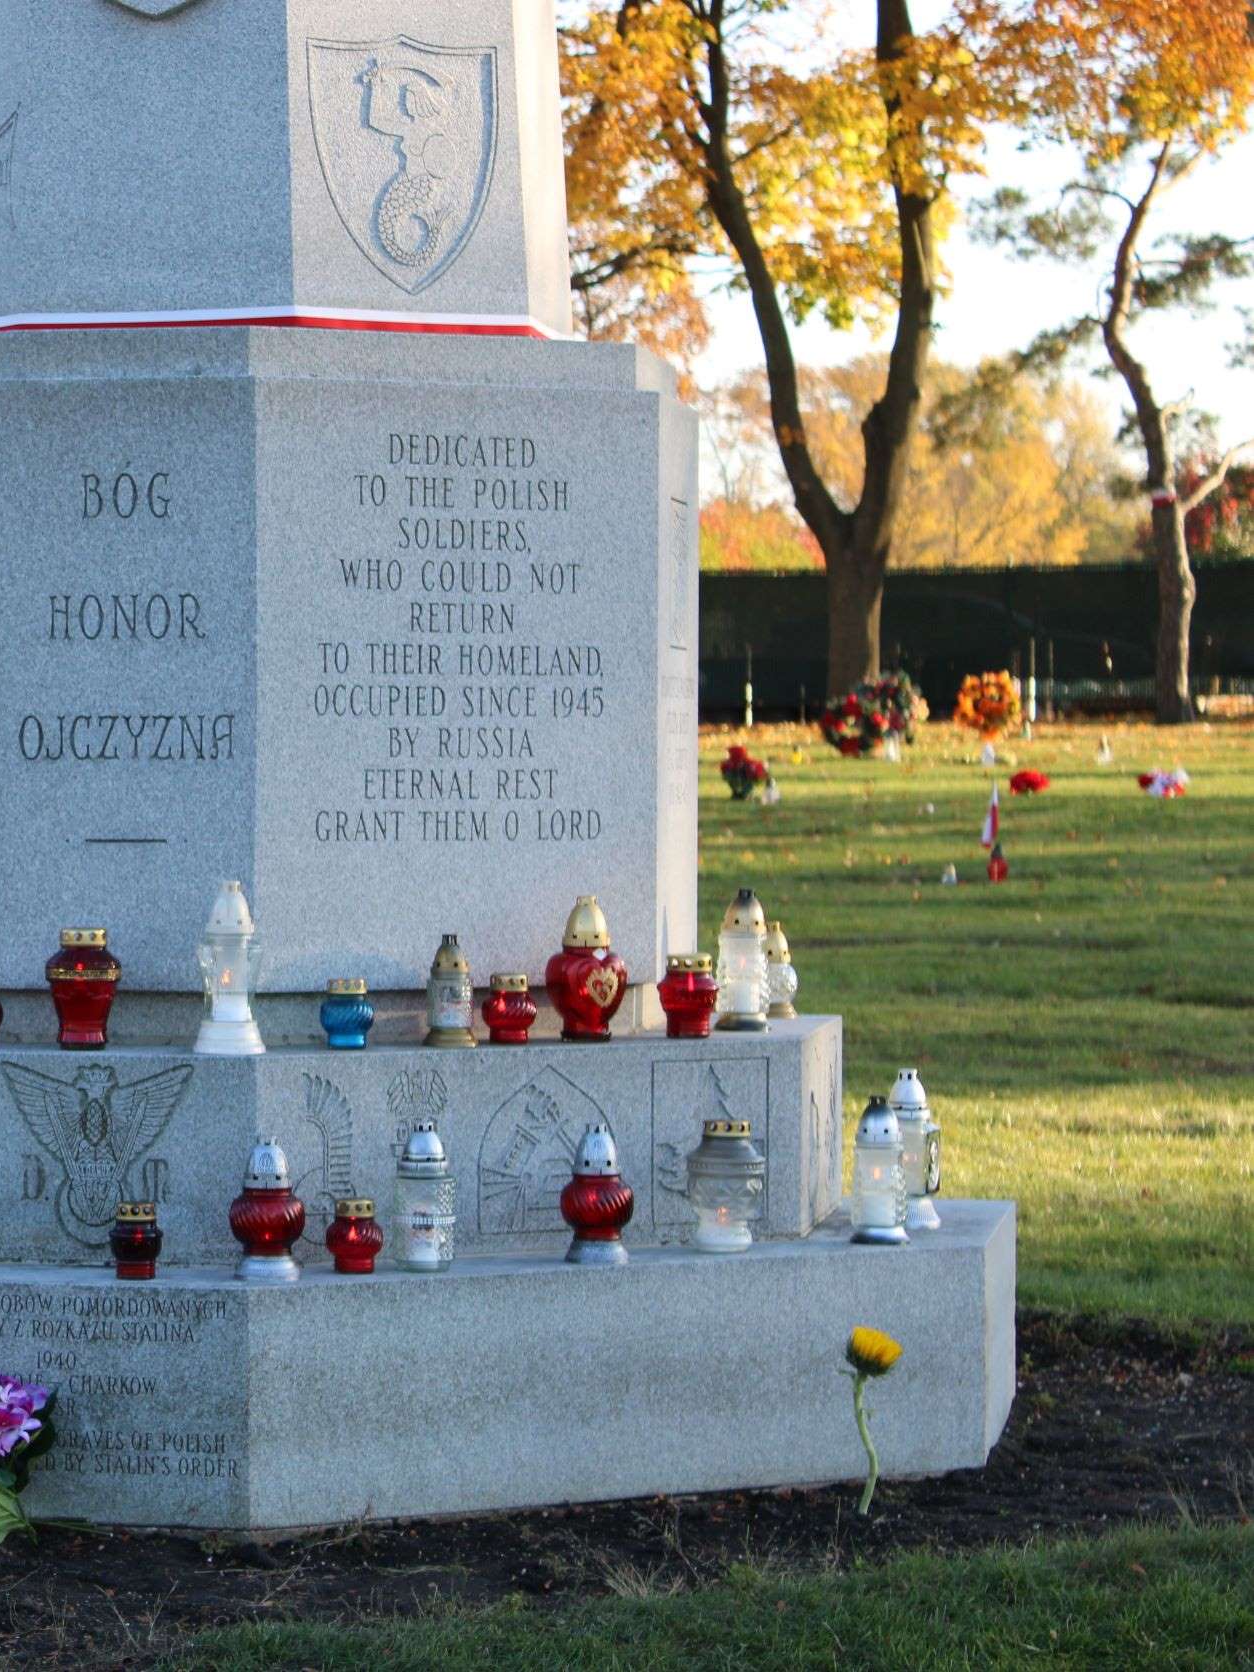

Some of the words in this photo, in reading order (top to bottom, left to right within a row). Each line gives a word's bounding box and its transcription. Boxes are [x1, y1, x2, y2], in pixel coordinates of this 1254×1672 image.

[389, 433, 536, 468] DEDICATED
[82, 461, 171, 519] BÓG
[354, 474, 386, 506] TO
[405, 476, 455, 508] THE
[474, 479, 569, 511] POLISH
[398, 517, 532, 554] SOLDIERS,
[340, 558, 403, 591] WHO
[421, 560, 512, 593] COULD
[530, 562, 582, 594] NOT
[48, 593, 206, 640] HONOR
[410, 602, 515, 634] RETURN
[317, 642, 349, 675] TO
[366, 643, 443, 676] THEIR
[459, 645, 604, 678] HOMELAND,
[314, 684, 445, 717] OCCUPIED
[462, 686, 537, 718] SINCE
[551, 686, 604, 718] 1945
[18, 714, 235, 760] OJCZYZNA
[389, 727, 420, 759] BY
[438, 727, 534, 759] RUSSIA
[364, 768, 480, 800] ETERNAL
[496, 768, 558, 800] REST
[315, 810, 404, 842] GRANT
[418, 810, 487, 841] THEM
[505, 810, 519, 841] O
[537, 809, 601, 841] LORD
[62, 1296, 226, 1319] POMORDOWANYCH
[14, 1319, 23, 1337] Z
[32, 1319, 112, 1341] ROZKAZU
[37, 1351, 76, 1370] 1940
[56, 1430, 125, 1451] GRAVES
[132, 1431, 153, 1450] OF
[162, 1432, 226, 1454] POLISH
[65, 1453, 84, 1473] BY
[95, 1455, 171, 1476] STALIN'S
[178, 1457, 239, 1478] ORDER
